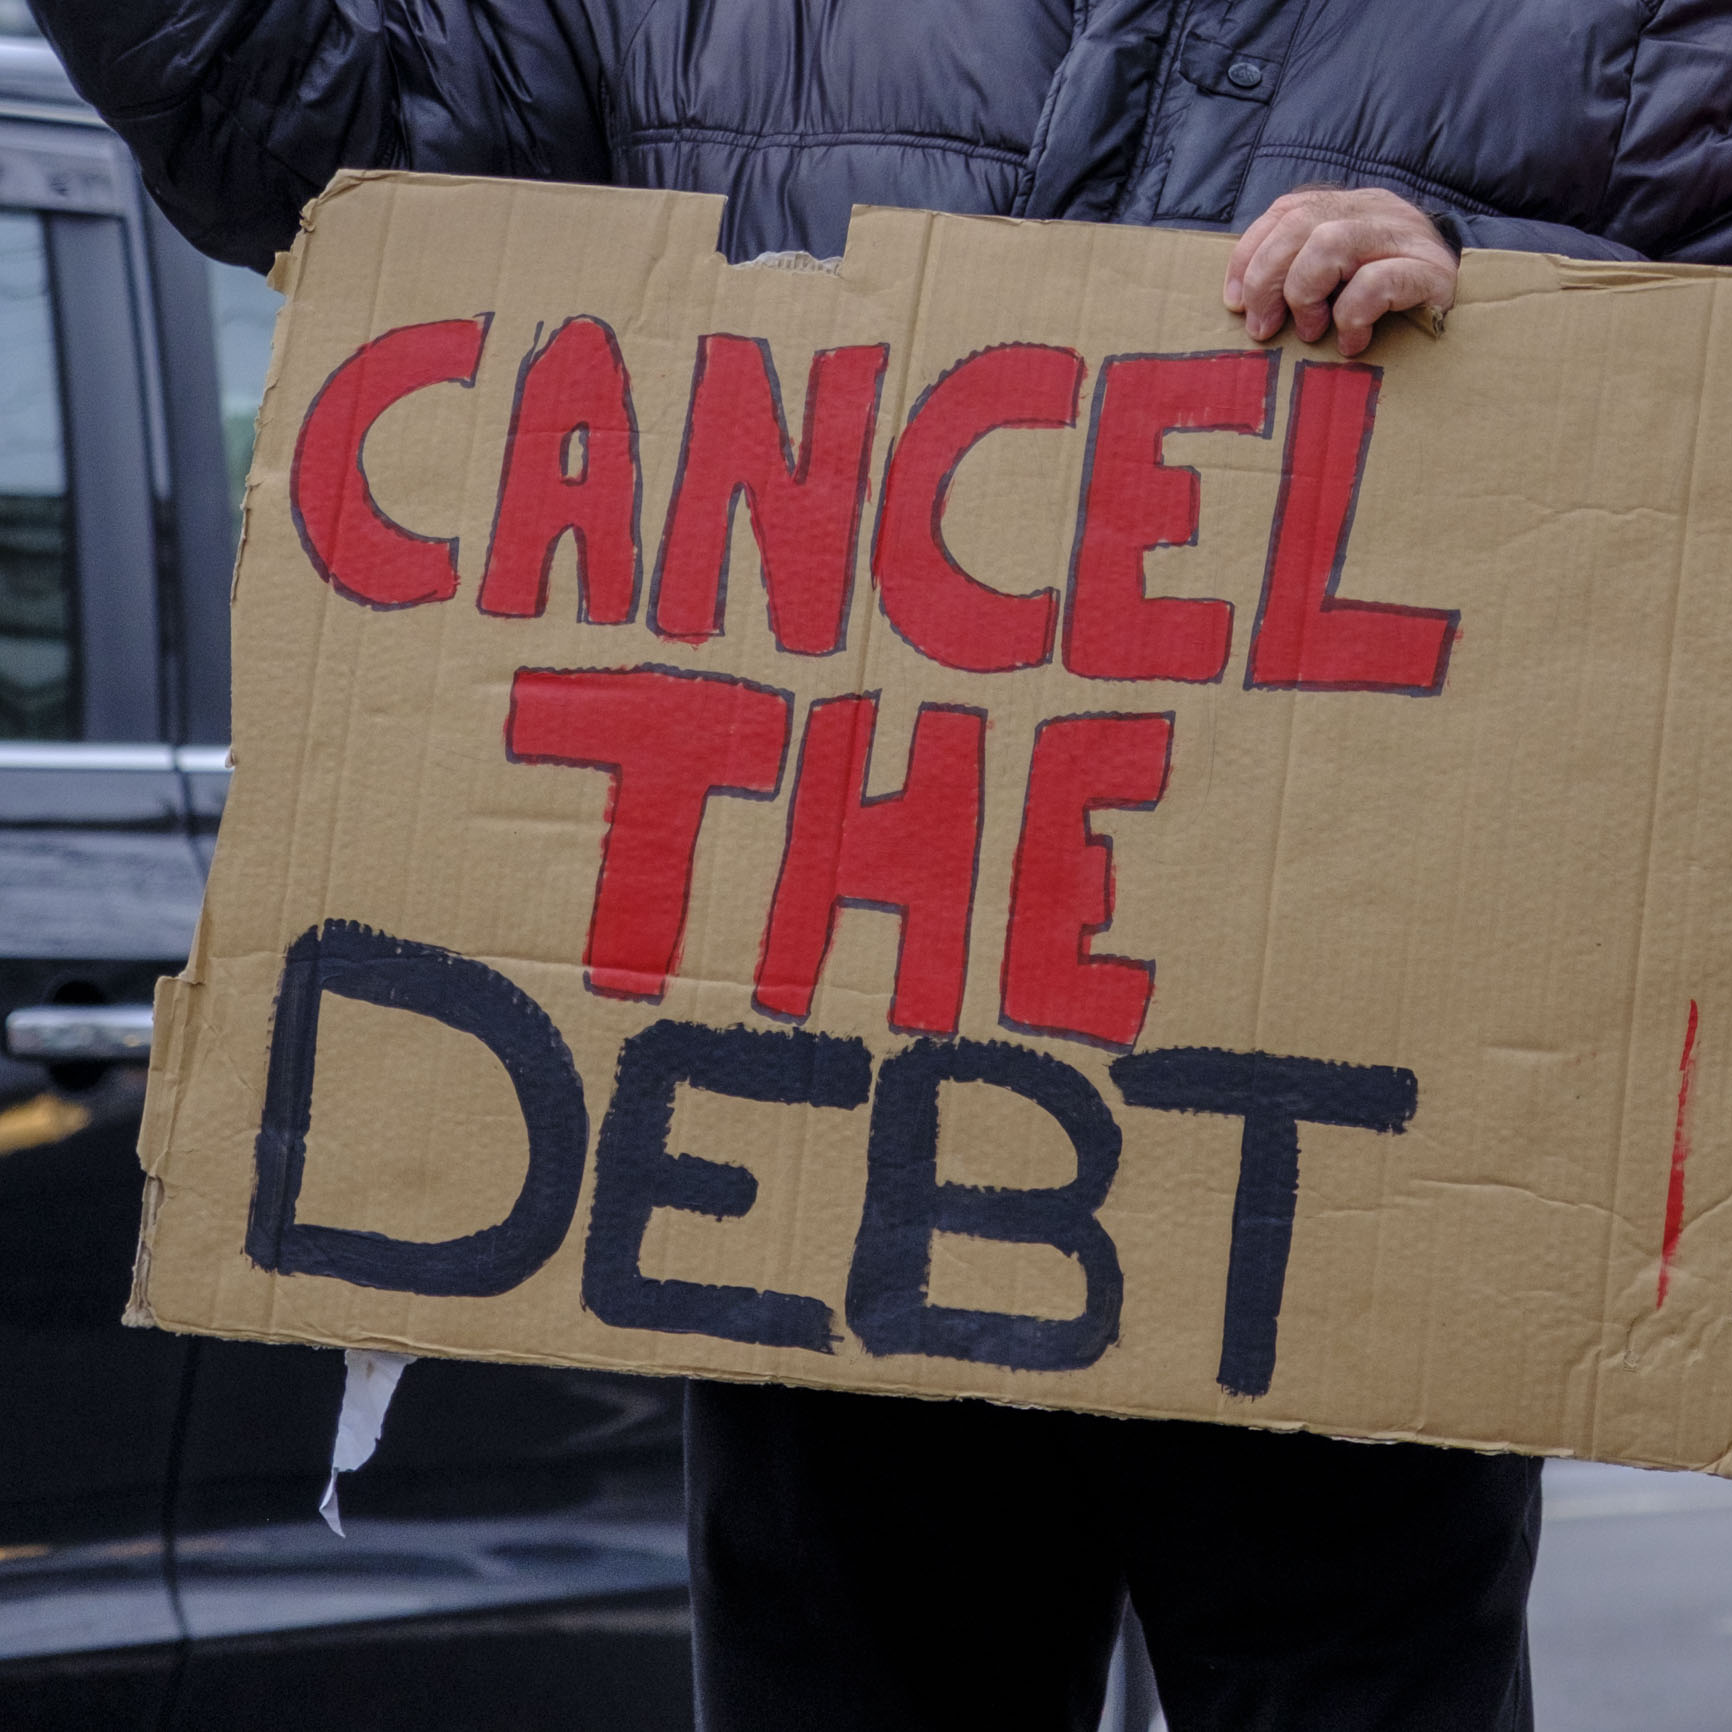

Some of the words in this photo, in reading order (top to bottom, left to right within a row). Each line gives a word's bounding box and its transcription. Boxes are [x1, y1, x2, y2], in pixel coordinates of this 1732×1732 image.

[291, 312, 1461, 694] CANCEL
[505, 665, 1177, 1051] THE
[246, 918, 1420, 1398] DEBT
